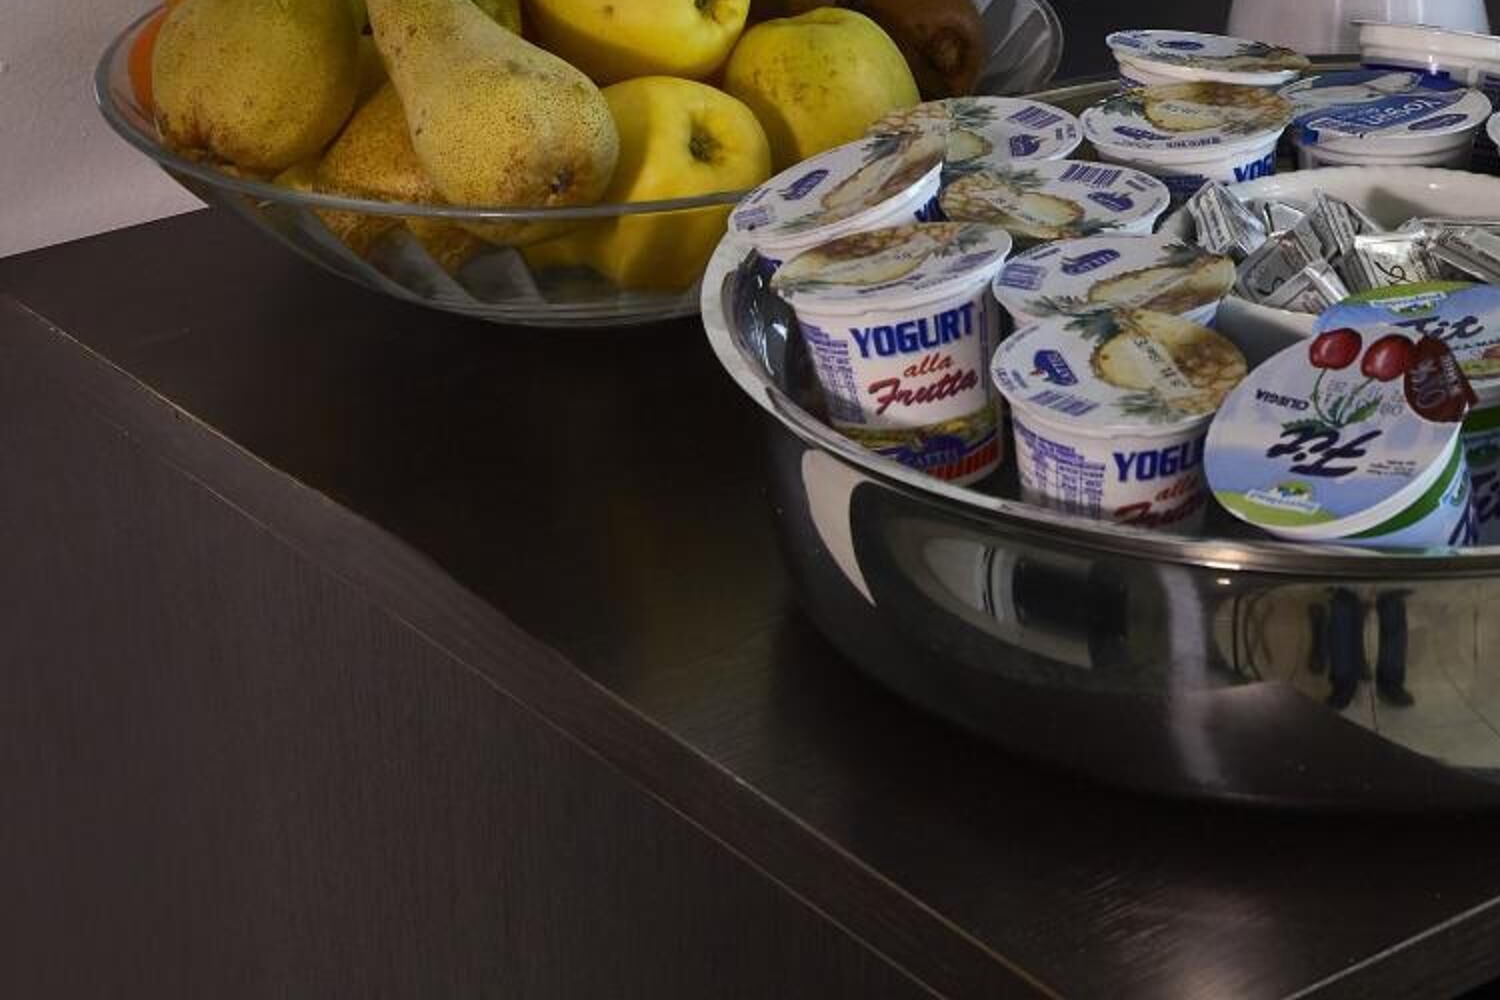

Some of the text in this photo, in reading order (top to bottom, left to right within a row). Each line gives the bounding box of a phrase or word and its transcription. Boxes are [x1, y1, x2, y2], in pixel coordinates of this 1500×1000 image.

[849, 301, 975, 359] YOGURT
[903, 352, 955, 379] alla
[867, 369, 979, 416] Frutta
[1265, 427, 1384, 479] Fit
